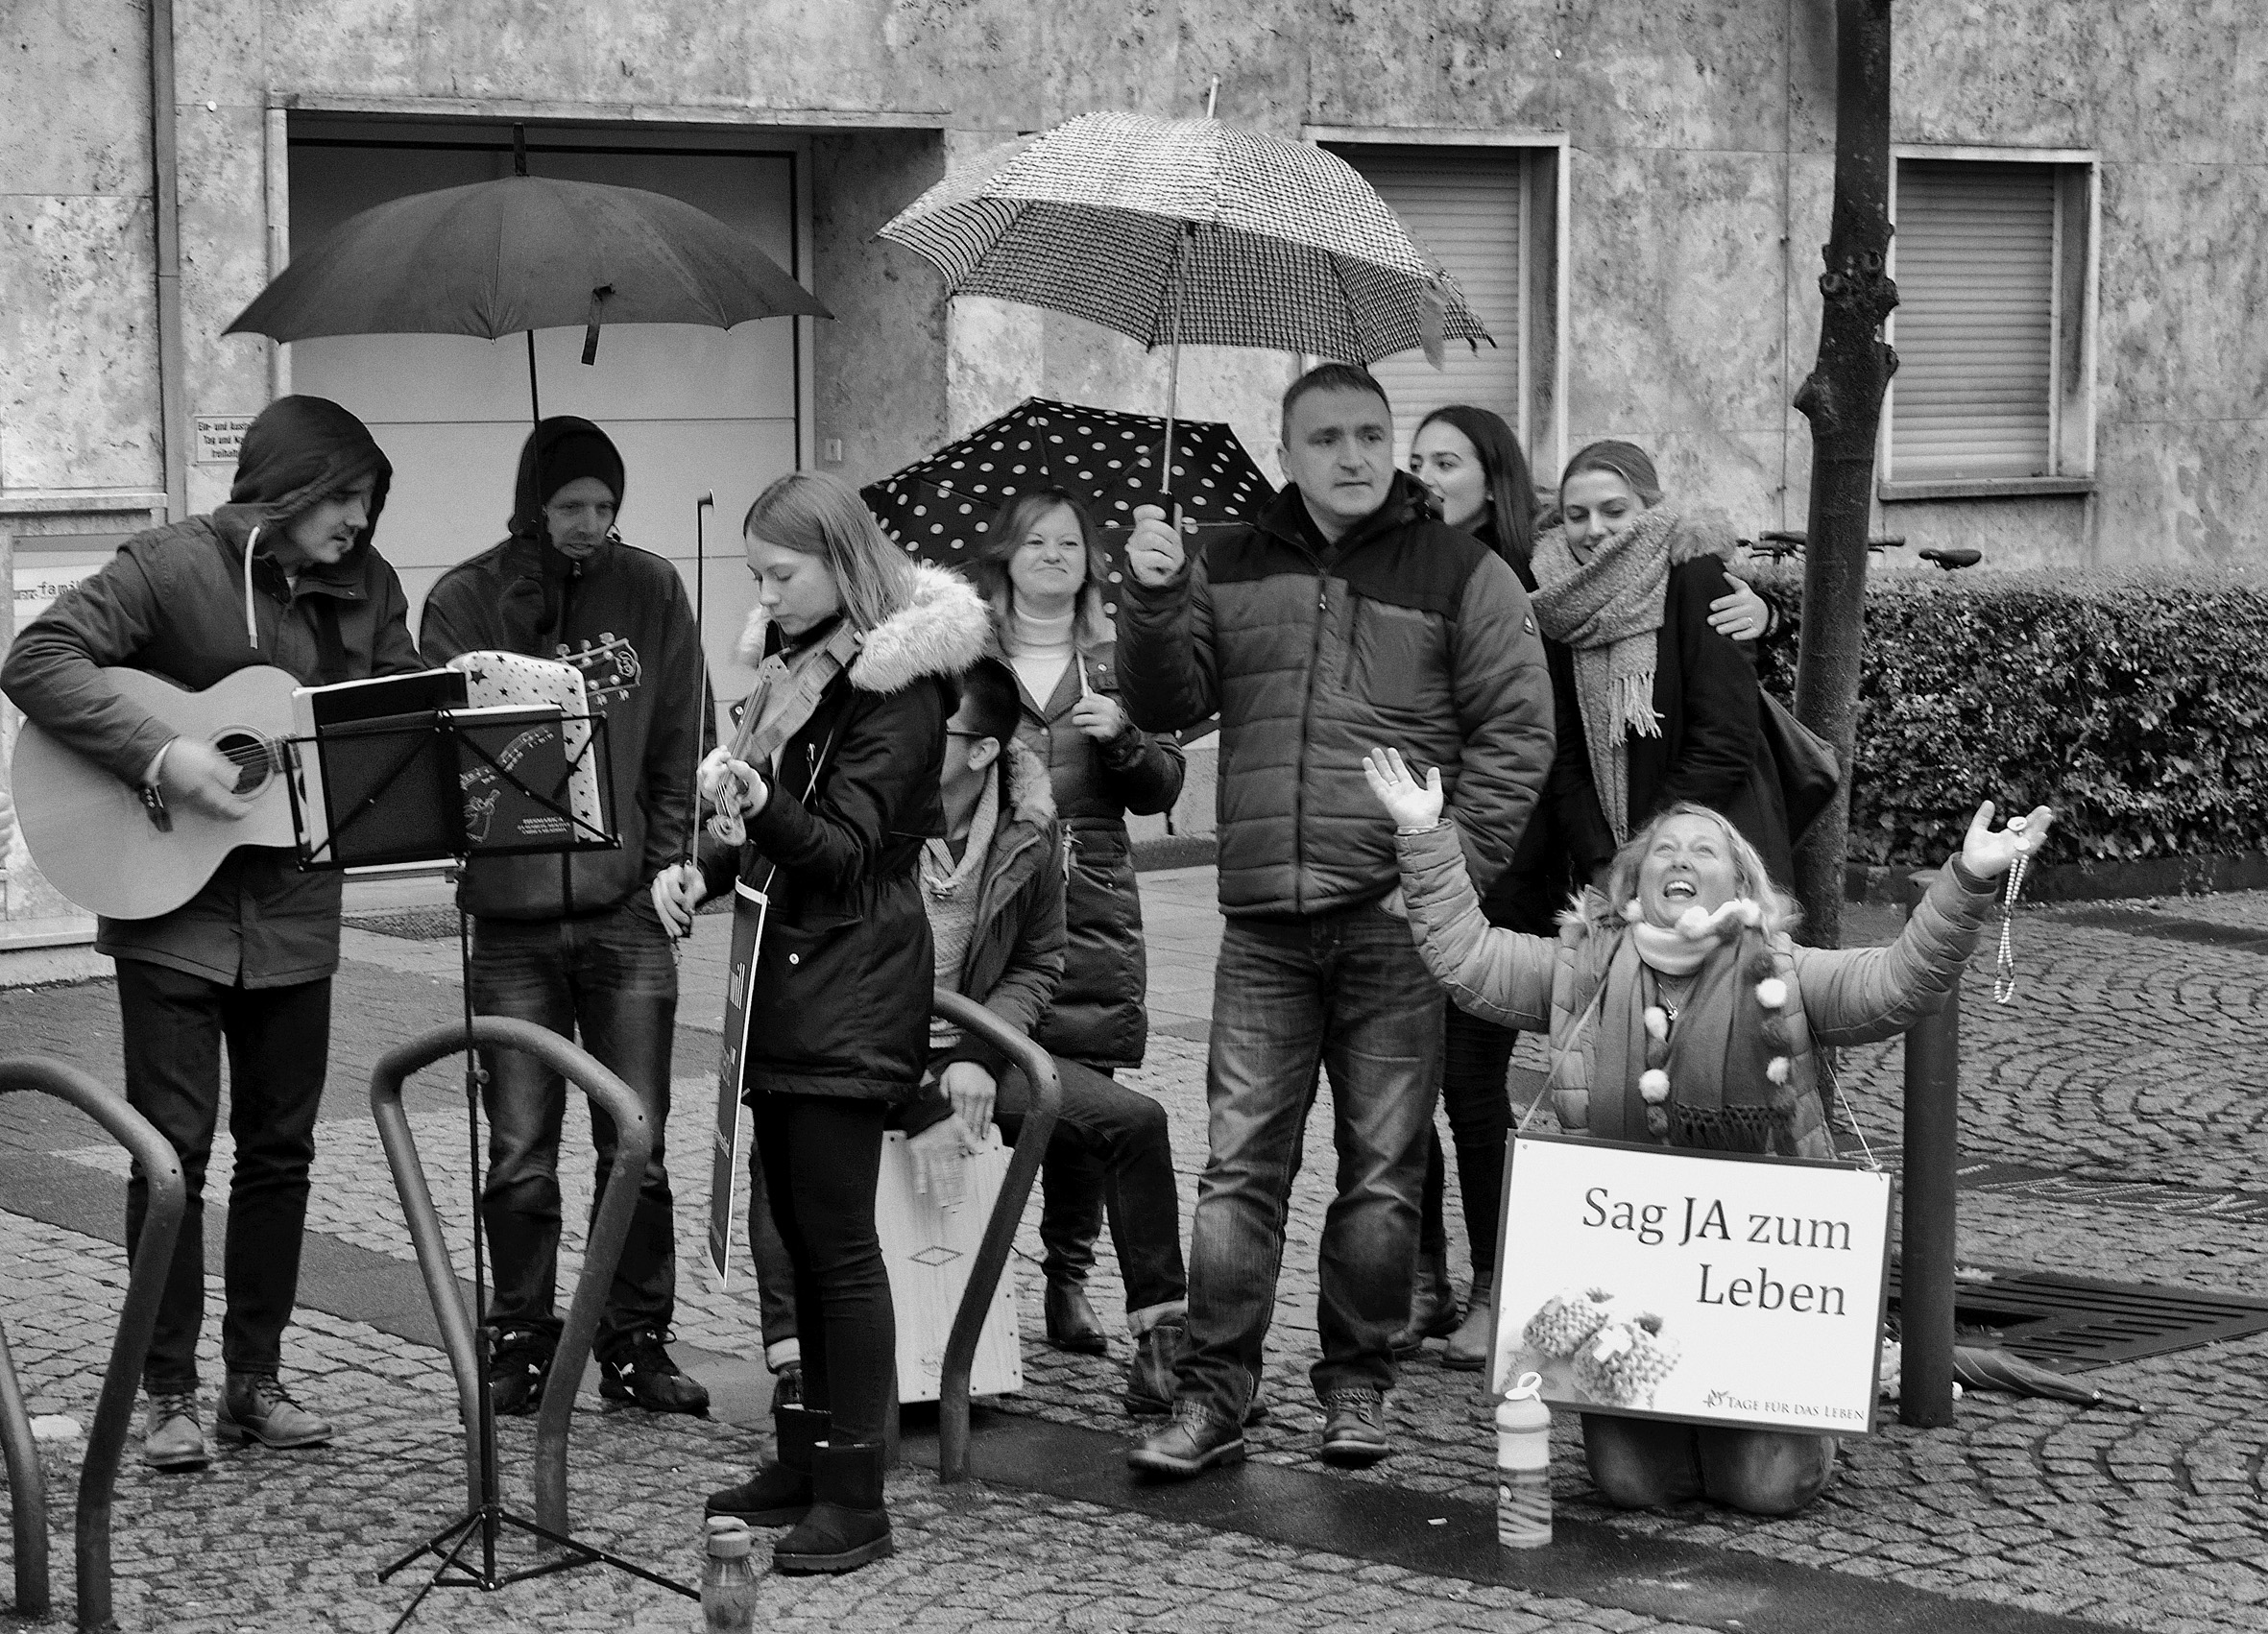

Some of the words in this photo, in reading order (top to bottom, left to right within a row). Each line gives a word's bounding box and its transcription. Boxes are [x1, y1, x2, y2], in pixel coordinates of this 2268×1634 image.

[214, 421, 227, 431] und
[217, 435, 230, 445] und
[1581, 1187, 1668, 1246] Sag
[1677, 1196, 1732, 1247] JA
[1747, 1213, 1852, 1251] zum
[1696, 1262, 1846, 1316] Leben
[1763, 1400, 1791, 1414] FÜR
[1793, 1404, 1820, 1416] DAS
